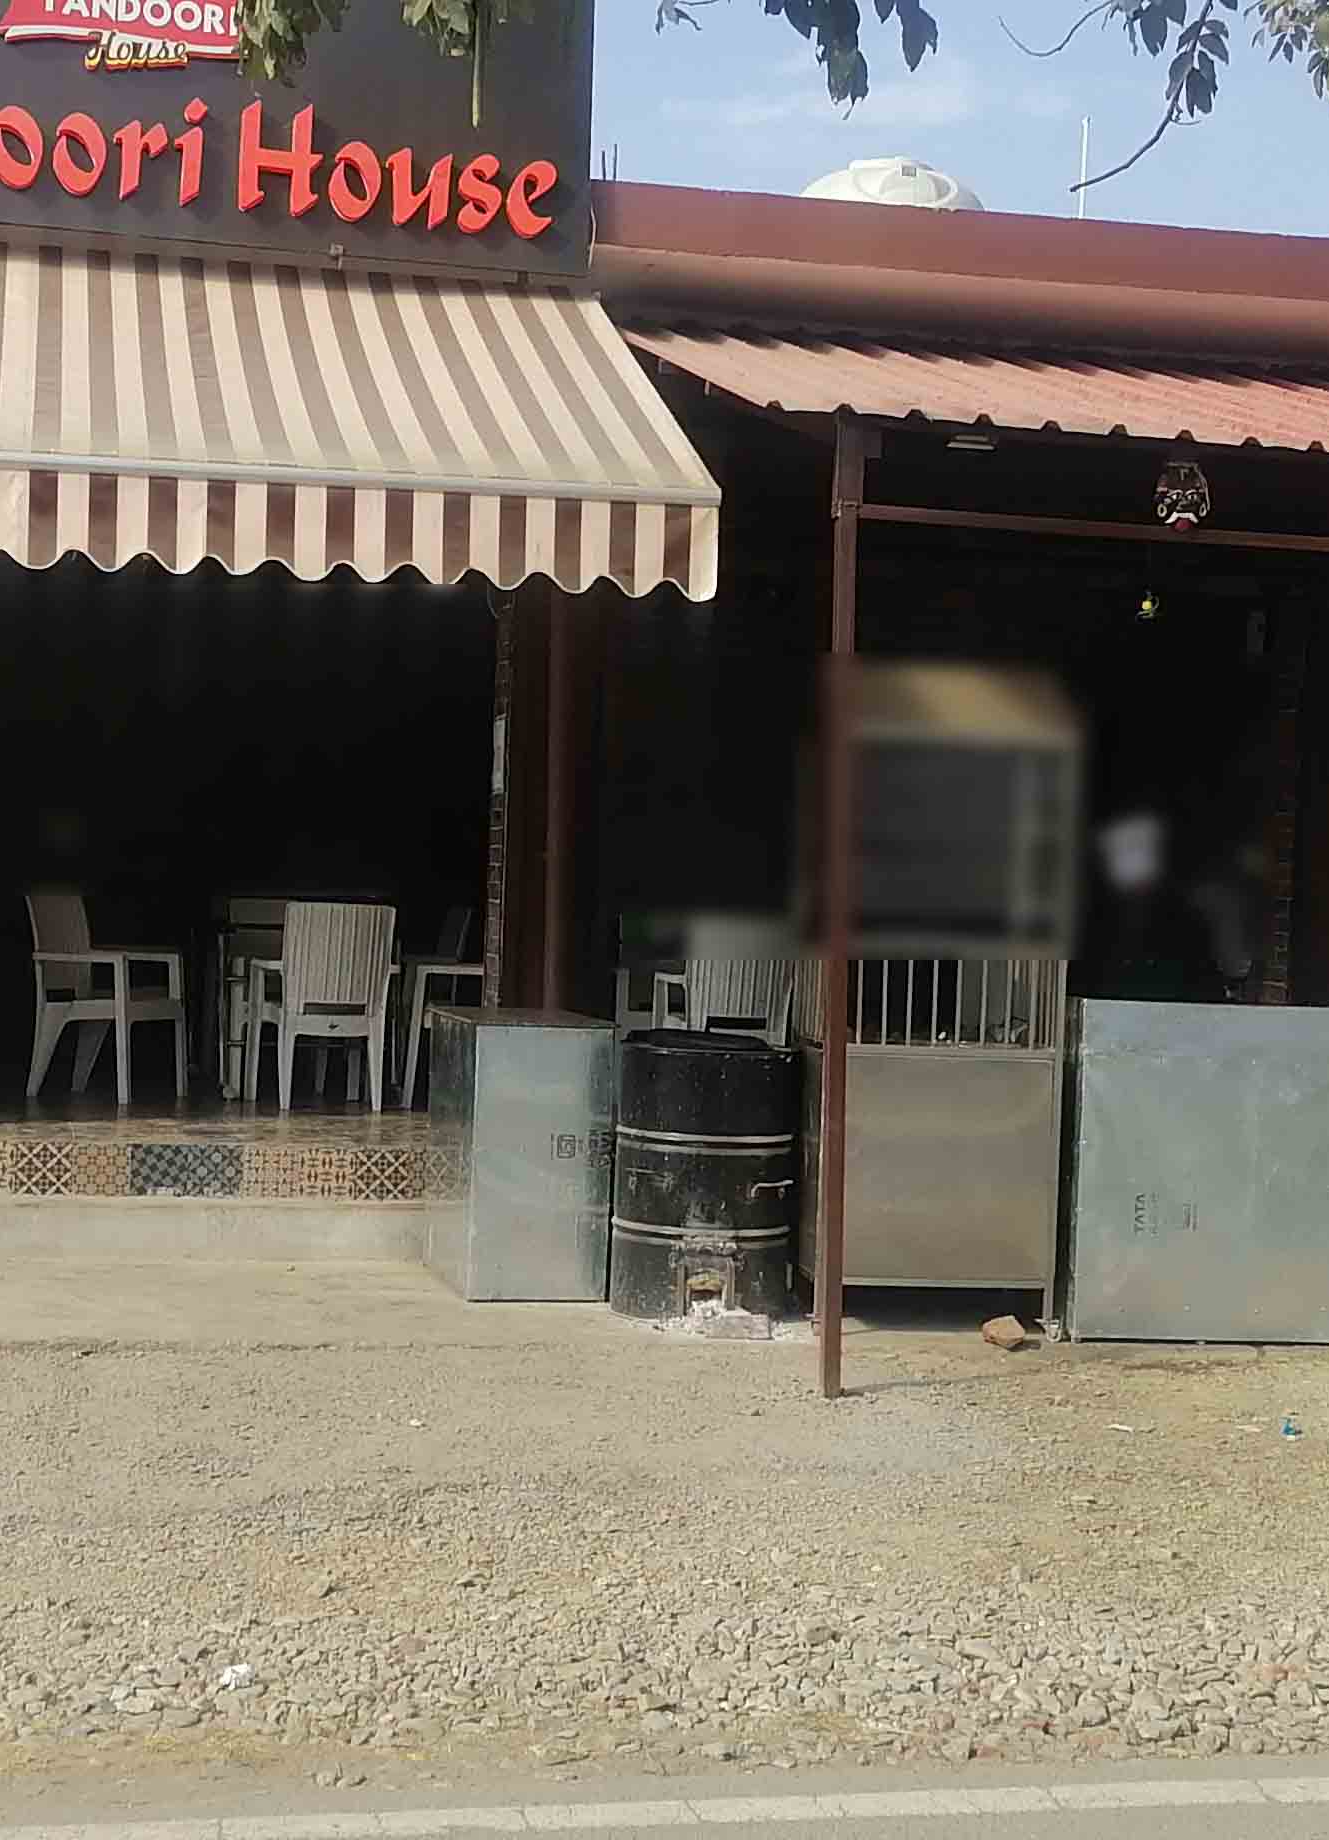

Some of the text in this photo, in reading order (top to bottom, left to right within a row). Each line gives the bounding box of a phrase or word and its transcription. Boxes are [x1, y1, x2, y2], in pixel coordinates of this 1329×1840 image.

[85, 31, 188, 70] House
[237, 98, 559, 239] House
[1134, 1193, 1145, 1235] TATA
